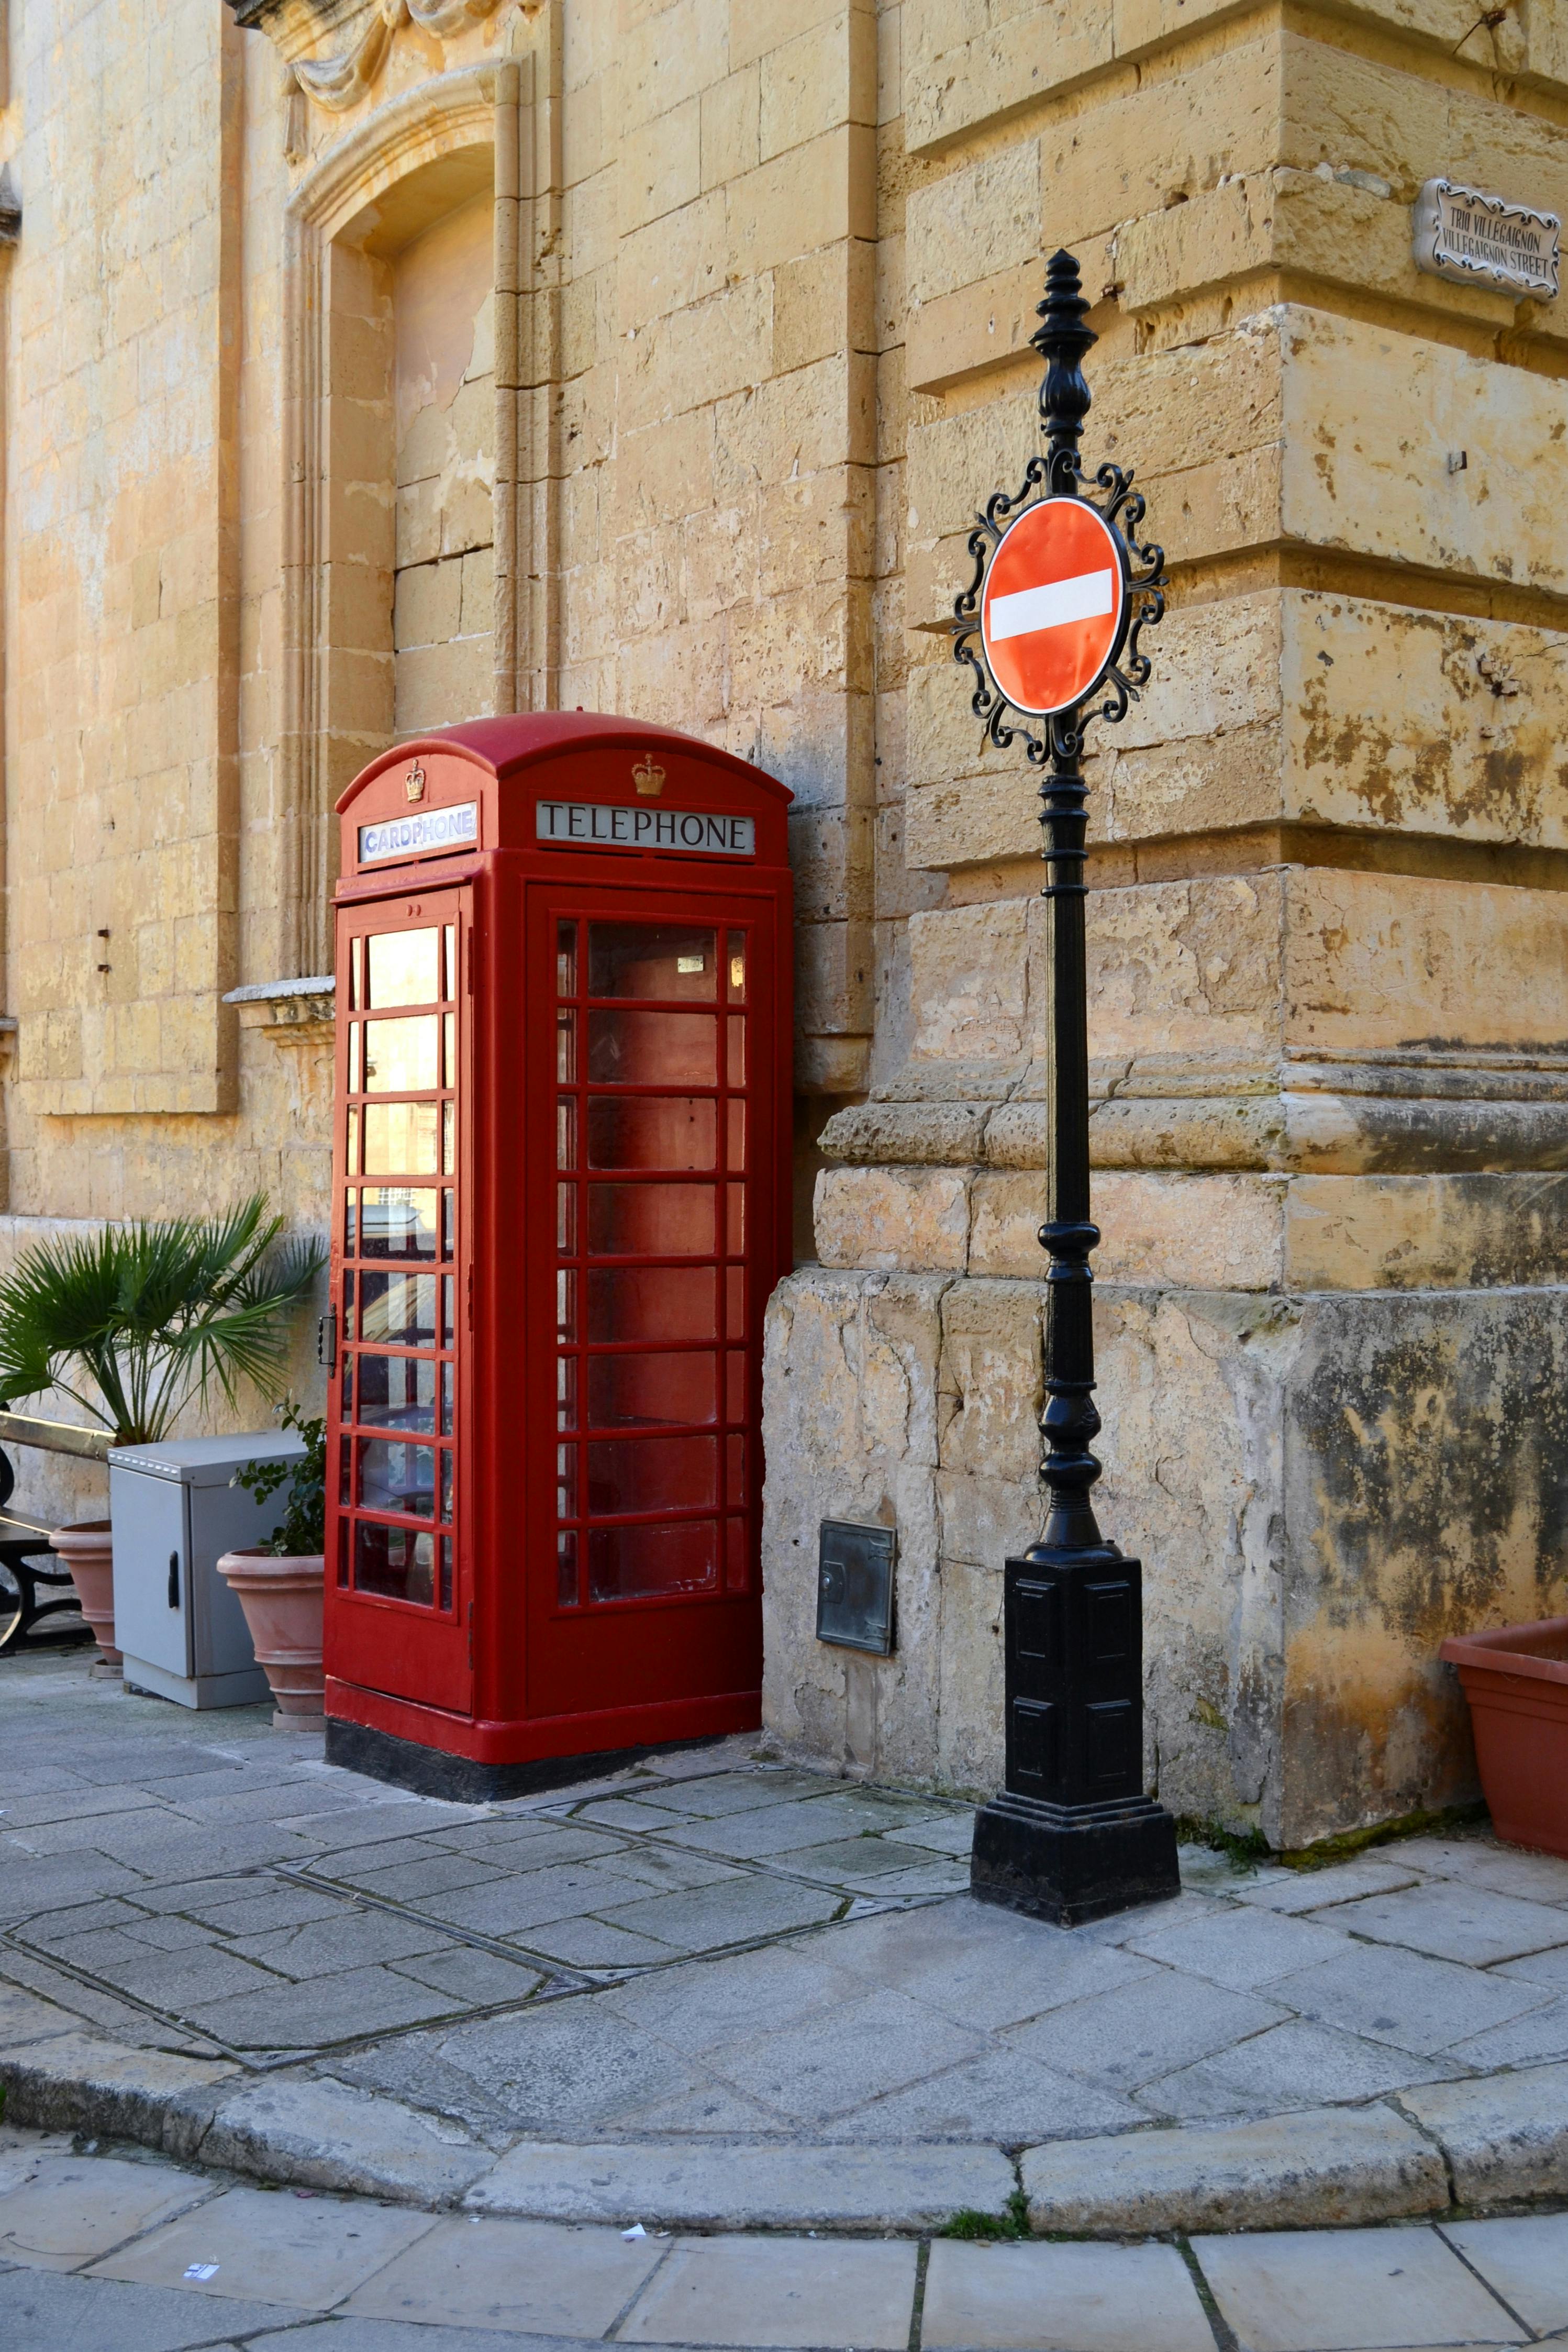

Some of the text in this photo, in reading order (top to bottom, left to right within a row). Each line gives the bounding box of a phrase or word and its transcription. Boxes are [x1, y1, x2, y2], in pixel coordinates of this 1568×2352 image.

[1442, 227, 1548, 279] VILLEGAIGNON STREET
[1474, 214, 1541, 253] VILLEGAIGNON
[365, 809, 472, 853] CARDPHONE
[541, 804, 747, 849] TELEPHONE
